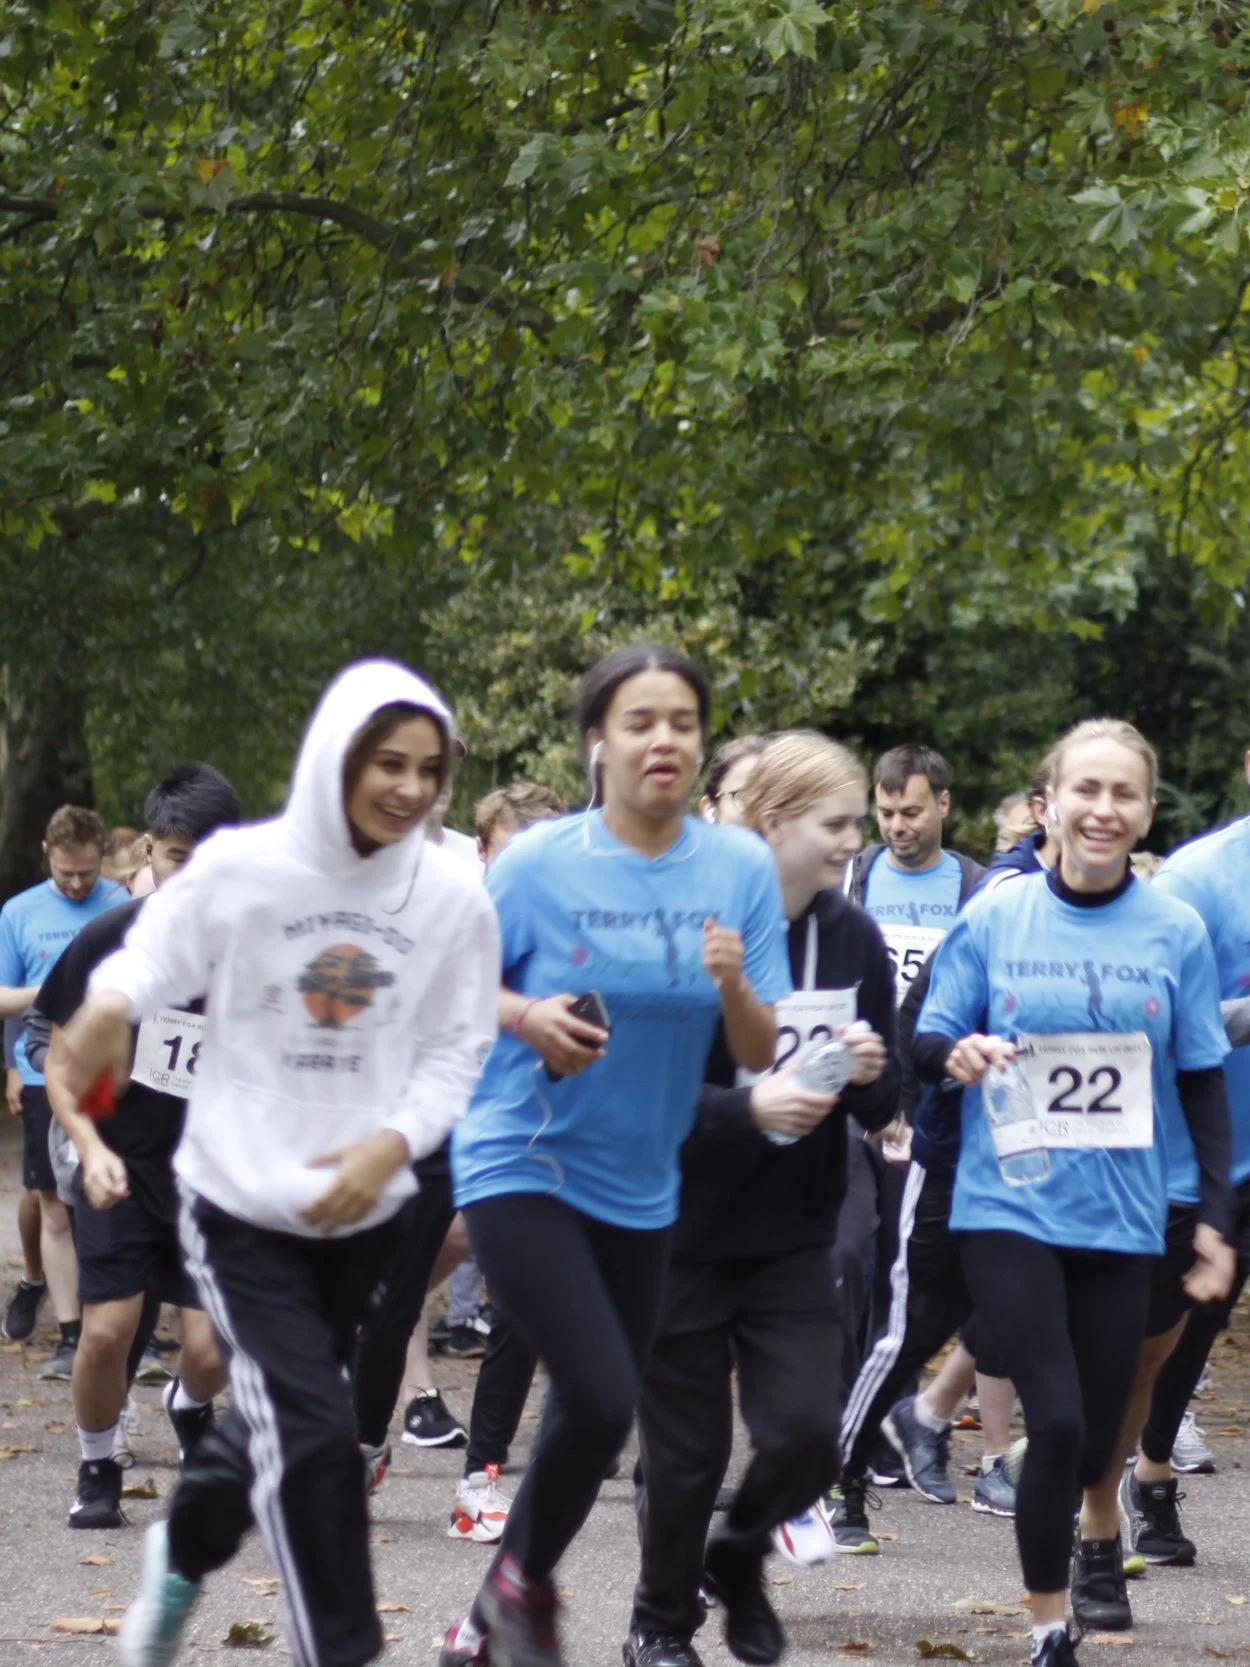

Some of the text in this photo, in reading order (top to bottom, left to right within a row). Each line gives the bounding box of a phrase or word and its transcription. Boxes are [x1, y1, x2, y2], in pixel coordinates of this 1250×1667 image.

[867, 904, 955, 917] ERRY FOX
[1005, 960, 1150, 985] TERRY FOX
[1047, 1065, 1123, 1114] 22
